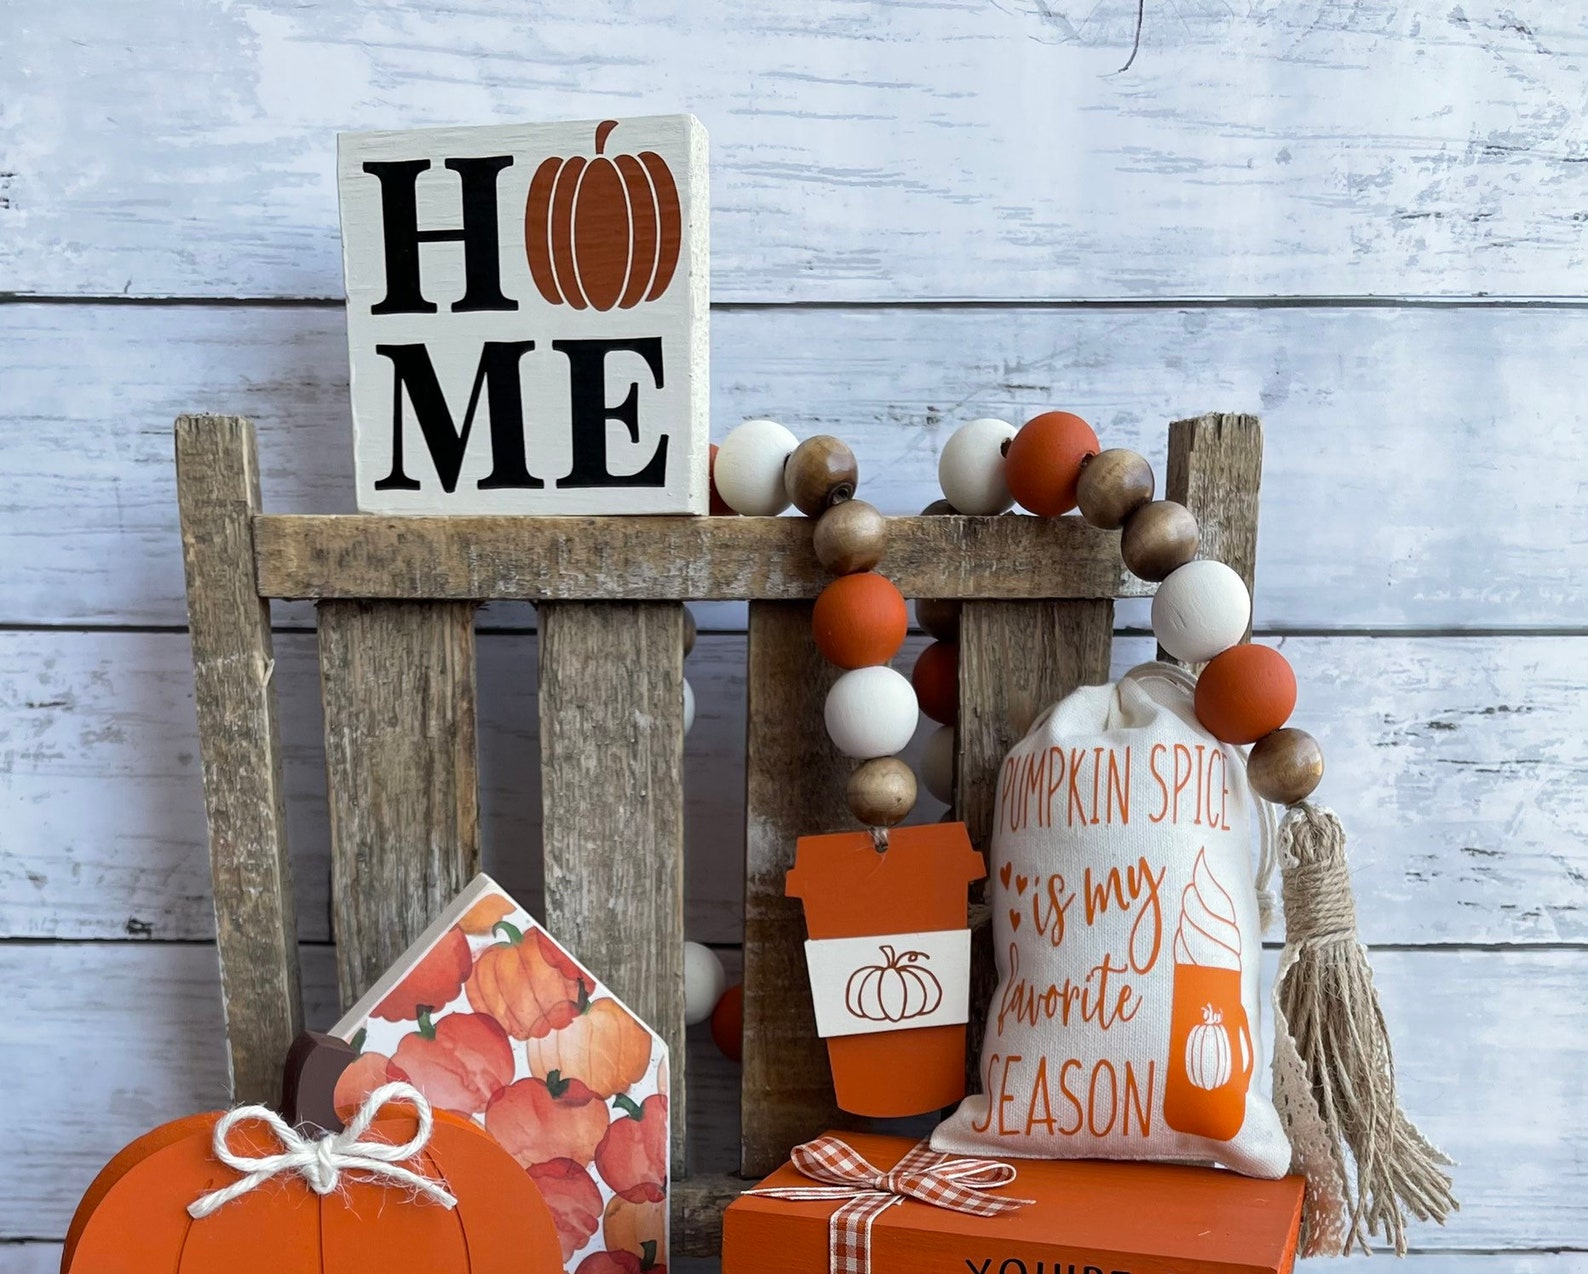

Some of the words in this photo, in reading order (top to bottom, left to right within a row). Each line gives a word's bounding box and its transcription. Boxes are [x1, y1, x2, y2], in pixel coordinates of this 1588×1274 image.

[374, 336, 669, 494] ME
[999, 745, 1132, 836] PUMPKIN
[1148, 742, 1232, 832] SPICE
[1032, 865, 1076, 948] is
[1083, 854, 1167, 976] my
[997, 942, 1143, 1037] favorite
[971, 1053, 1156, 1138] SEASON
